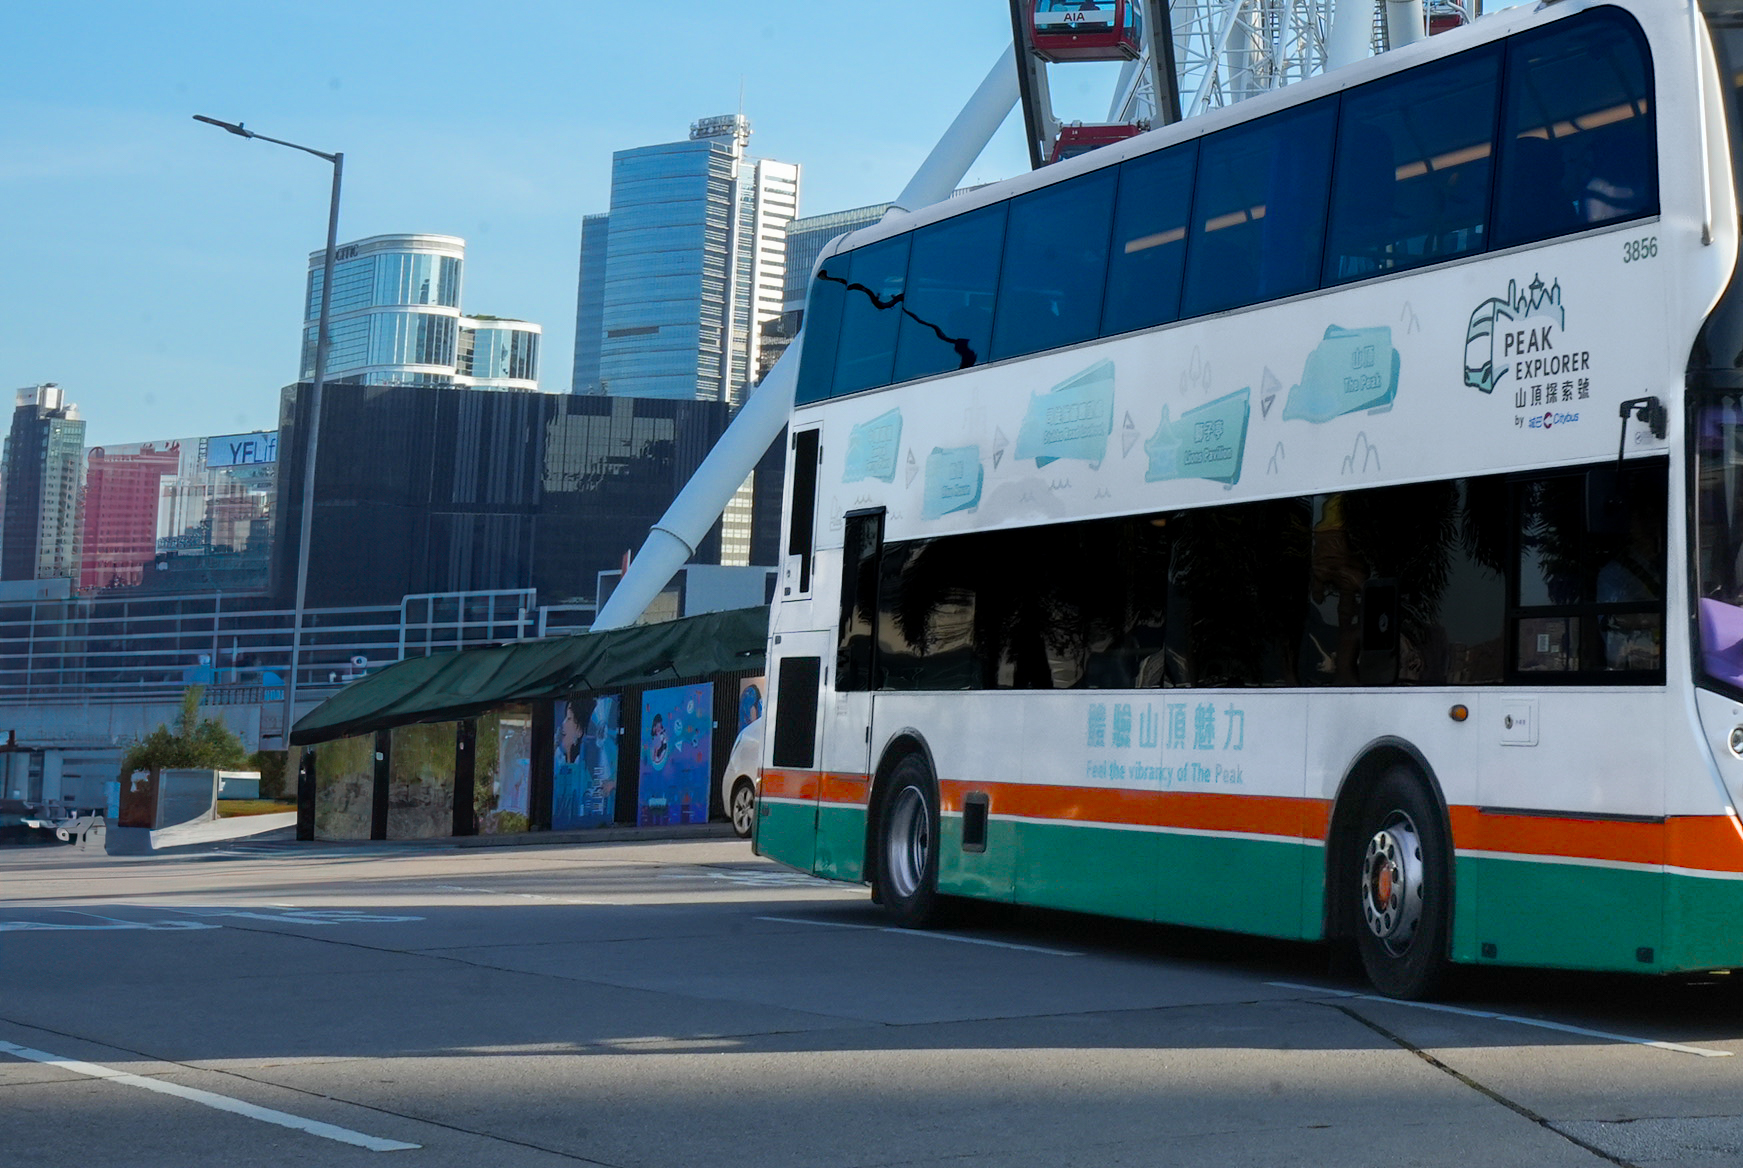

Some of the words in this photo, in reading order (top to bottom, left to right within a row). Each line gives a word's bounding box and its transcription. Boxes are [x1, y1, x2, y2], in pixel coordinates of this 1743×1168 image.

[1063, 12, 1085, 22] AIA
[1623, 237, 1658, 263] 3856
[1504, 325, 1553, 357] PEAK
[1516, 351, 1590, 380] EXPLORER
[1515, 378, 1590, 409] 山頂探索號
[1515, 415, 1525, 428] by
[1553, 412, 1580, 425] Citybus
[1177, 762, 1189, 781] of
[1191, 762, 1211, 783] The
[1215, 764, 1244, 784] Peak
